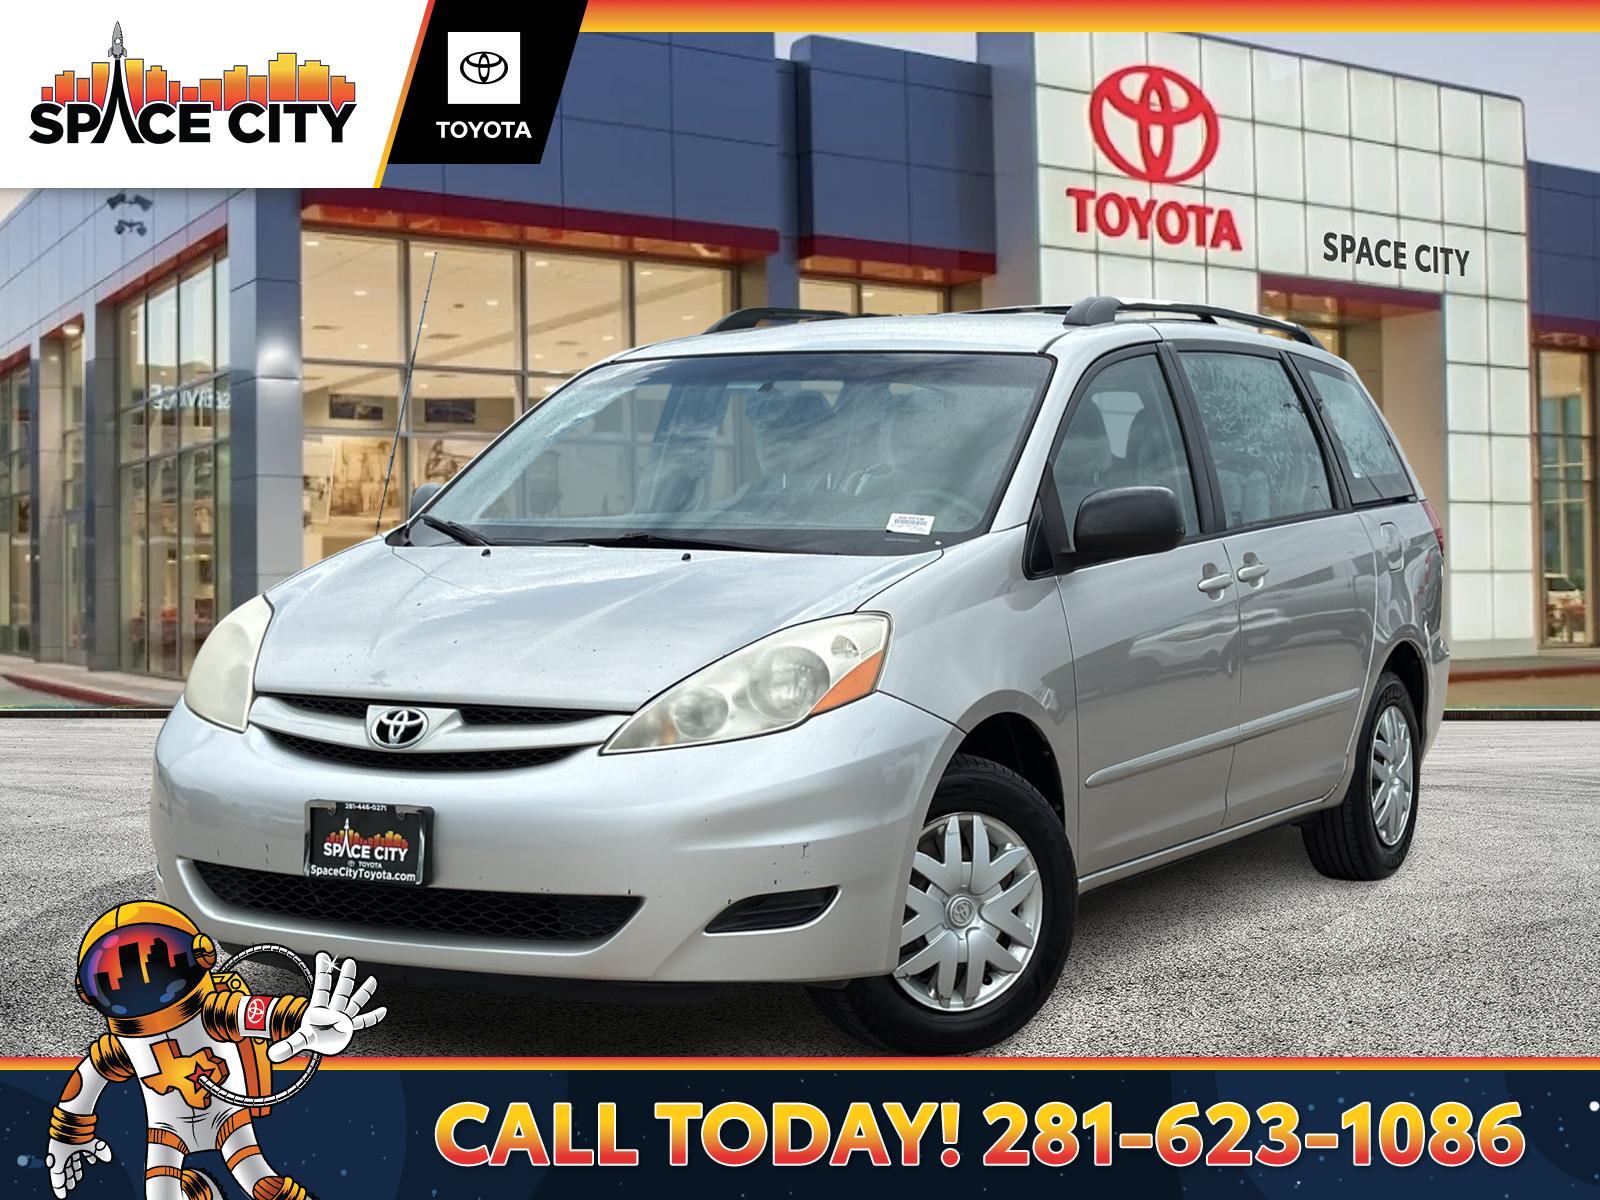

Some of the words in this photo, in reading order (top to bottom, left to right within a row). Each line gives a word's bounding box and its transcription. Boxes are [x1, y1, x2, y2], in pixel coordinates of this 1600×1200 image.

[1066, 187, 1242, 251] TOYOTA
[1323, 232, 1407, 270] SPACE
[1414, 244, 1470, 277] CITY
[323, 842, 370, 859] SPACE
[374, 846, 408, 861] CITY
[310, 864, 416, 882] SpaceCityToyota.com
[359, 861, 382, 869] TOYOTA
